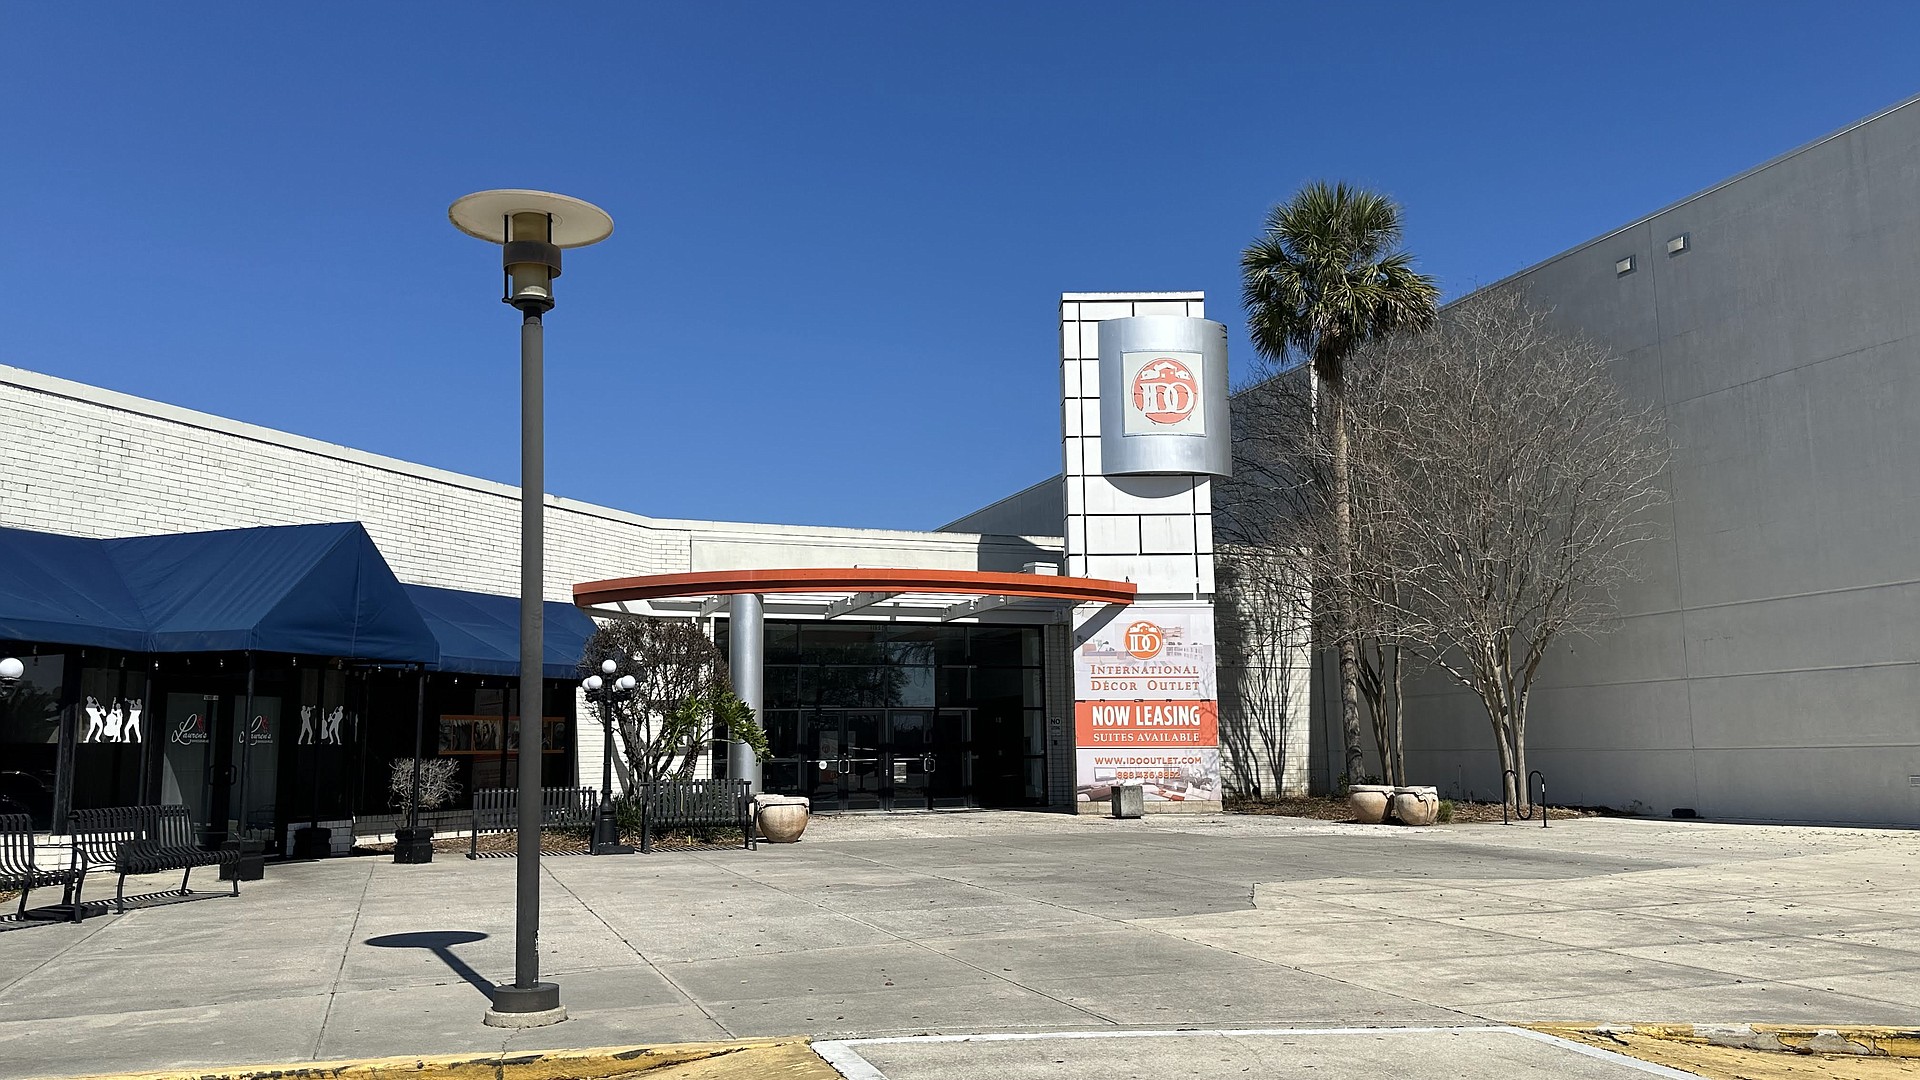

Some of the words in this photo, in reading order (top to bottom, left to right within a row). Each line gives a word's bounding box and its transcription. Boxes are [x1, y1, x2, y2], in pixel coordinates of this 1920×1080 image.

[1128, 634, 1160, 652] IDO
[1091, 665, 1199, 675] INTERNATIONAL
[1091, 679, 1138, 691] DÉCOR
[1147, 679, 1200, 691] OUTLET
[1092, 706, 1130, 726] NOW
[1136, 706, 1200, 726] LEASING
[1093, 733, 1134, 742] SUITES
[1137, 733, 1200, 742] AVAILABLE
[1094, 756, 1202, 765] WWW.IDOOUTLET.COM
